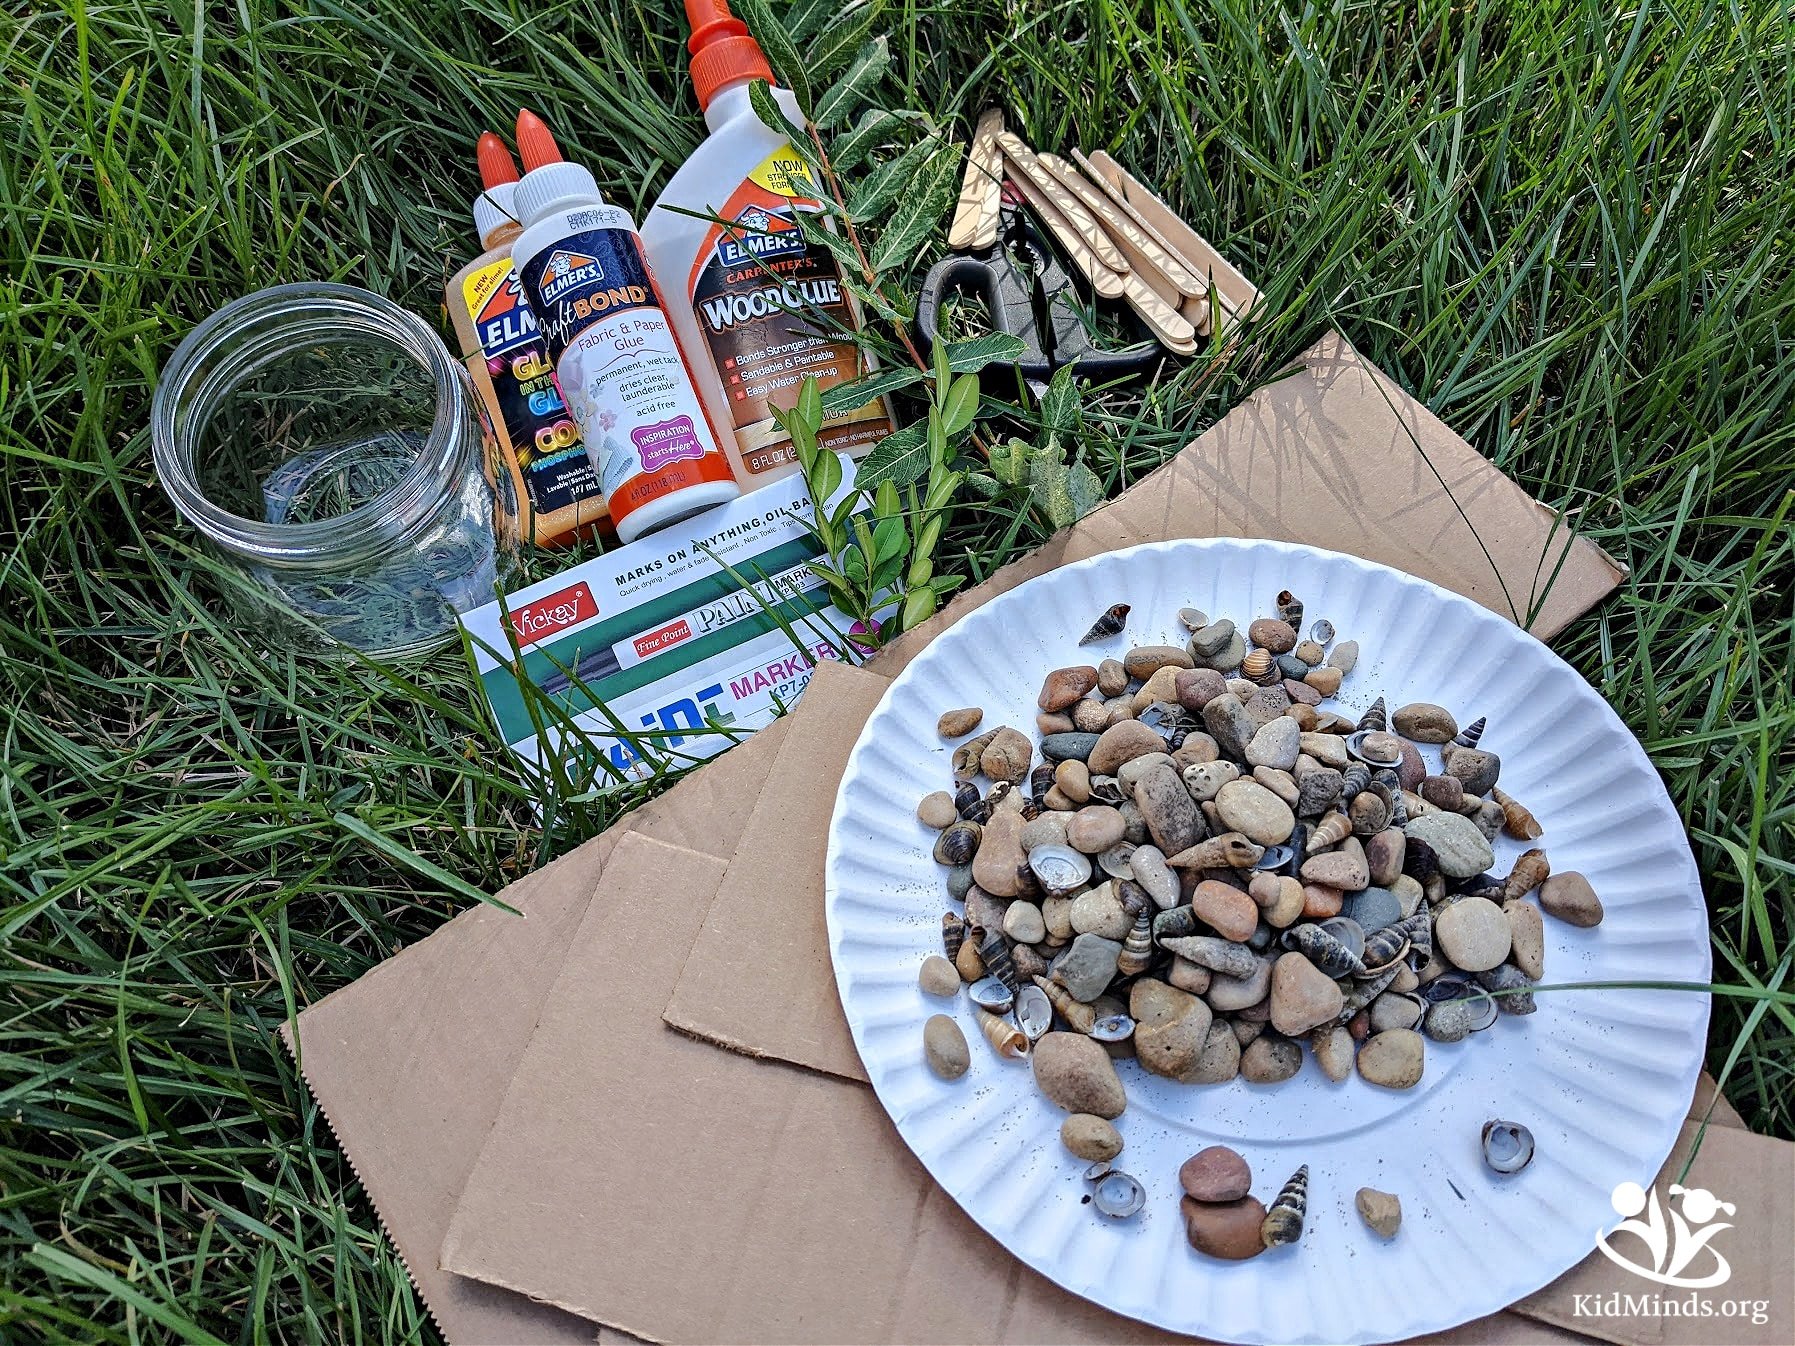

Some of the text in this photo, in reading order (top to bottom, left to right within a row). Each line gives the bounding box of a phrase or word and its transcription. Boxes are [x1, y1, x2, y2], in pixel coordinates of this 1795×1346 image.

[772, 160, 803, 172] NOW
[544, 264, 598, 301] ELMER'S
[726, 257, 813, 283] CARPNTER'S
[474, 274, 488, 293] NEW
[472, 294, 485, 310] Great
[481, 284, 491, 294] for
[486, 310, 537, 348] ELM
[578, 320, 664, 352] Fabric & Paper
[614, 336, 645, 351] Glue
[735, 350, 766, 366] Bonds
[766, 339, 809, 355] Stronger
[512, 350, 555, 381] GL
[595, 360, 646, 387] permanent,
[646, 356, 664, 367] wet
[740, 350, 835, 381] Sandable & Paintable
[520, 375, 556, 397] IN TH
[619, 373, 669, 393] dries clear,
[621, 381, 675, 402] launderable
[745, 366, 838, 397] Easy Water Can-up
[528, 386, 566, 416] GL
[636, 400, 676, 417] acid free
[534, 419, 578, 453] CO
[640, 424, 690, 446] INSPIRATION
[530, 443, 588, 473] PHOSPHO
[647, 439, 692, 460] starts Here
[751, 446, 798, 470] 8 FL OZ (2
[546, 481, 569, 493] Lavable
[556, 467, 586, 481] Washable
[585, 480, 598, 491] mL
[614, 560, 663, 586] MARKS
[667, 549, 687, 564] ON
[619, 584, 640, 597] Quick
[641, 575, 663, 588] drying
[667, 565, 686, 577] water
[687, 561, 693, 569] &
[694, 556, 710, 565] fade
[743, 534, 759, 545] Non
[759, 527, 777, 538] Toxic
[781, 519, 796, 528] Tips
[636, 624, 690, 654] Fine Point
